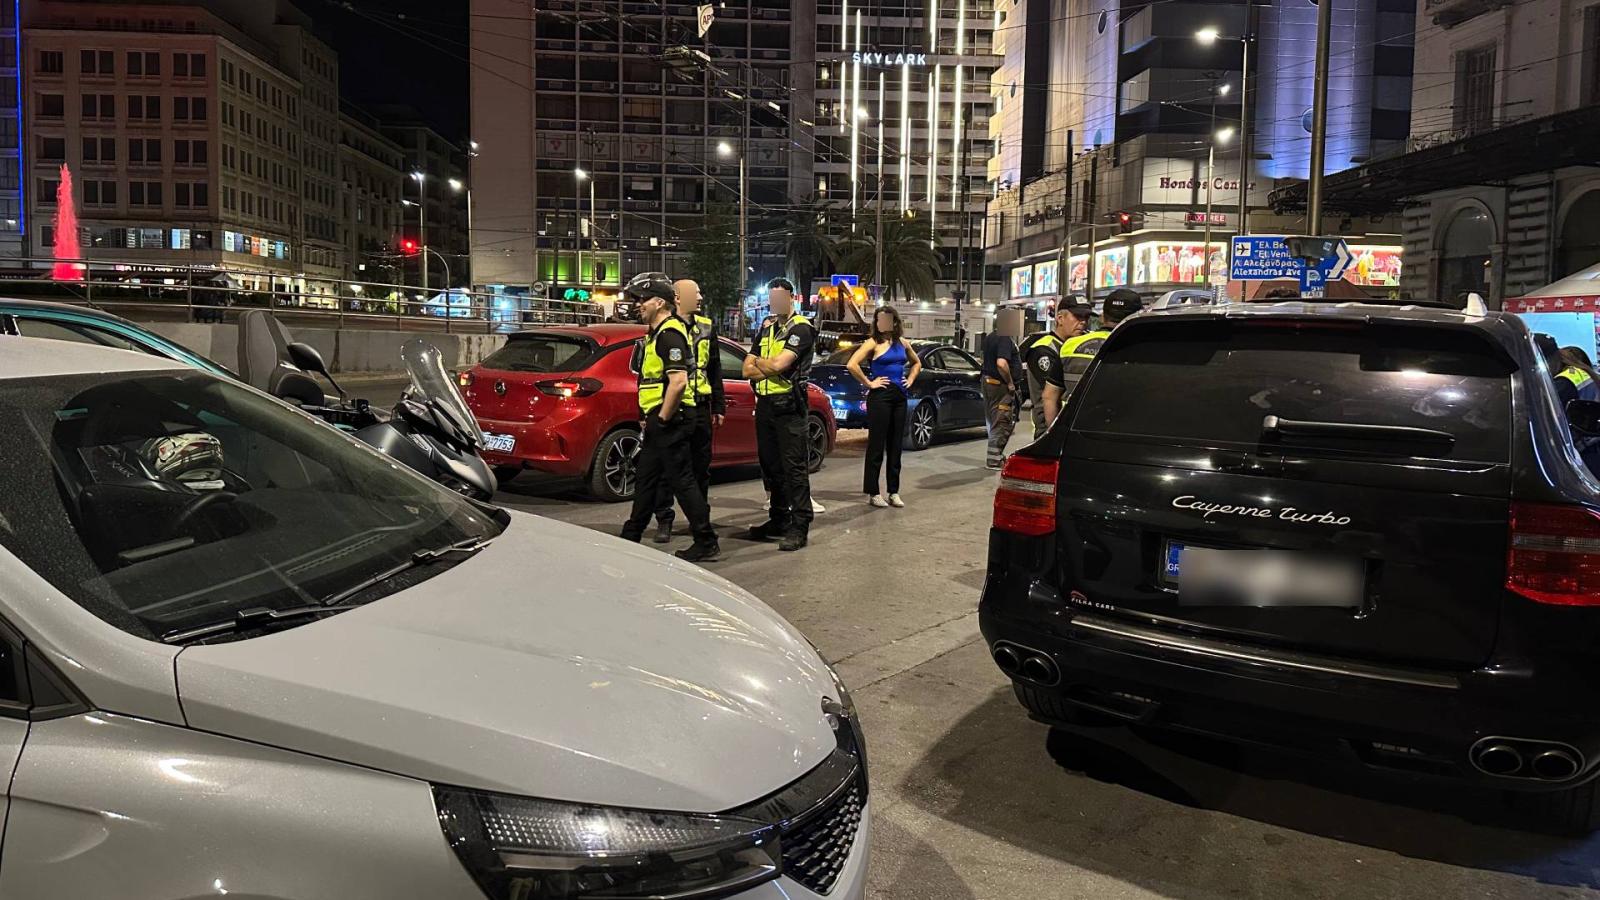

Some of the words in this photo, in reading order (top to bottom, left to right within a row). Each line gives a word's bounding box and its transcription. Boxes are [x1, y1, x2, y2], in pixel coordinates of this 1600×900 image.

[852, 52, 926, 65] SKYLARK
[1160, 177, 1208, 189] Hondos
[1213, 178, 1256, 190] Cenr
[1233, 268, 1283, 276] Alexandras
[1172, 495, 1273, 518] Cayenne
[1279, 507, 1351, 525] turbo
[1095, 602, 1115, 611] CARS
